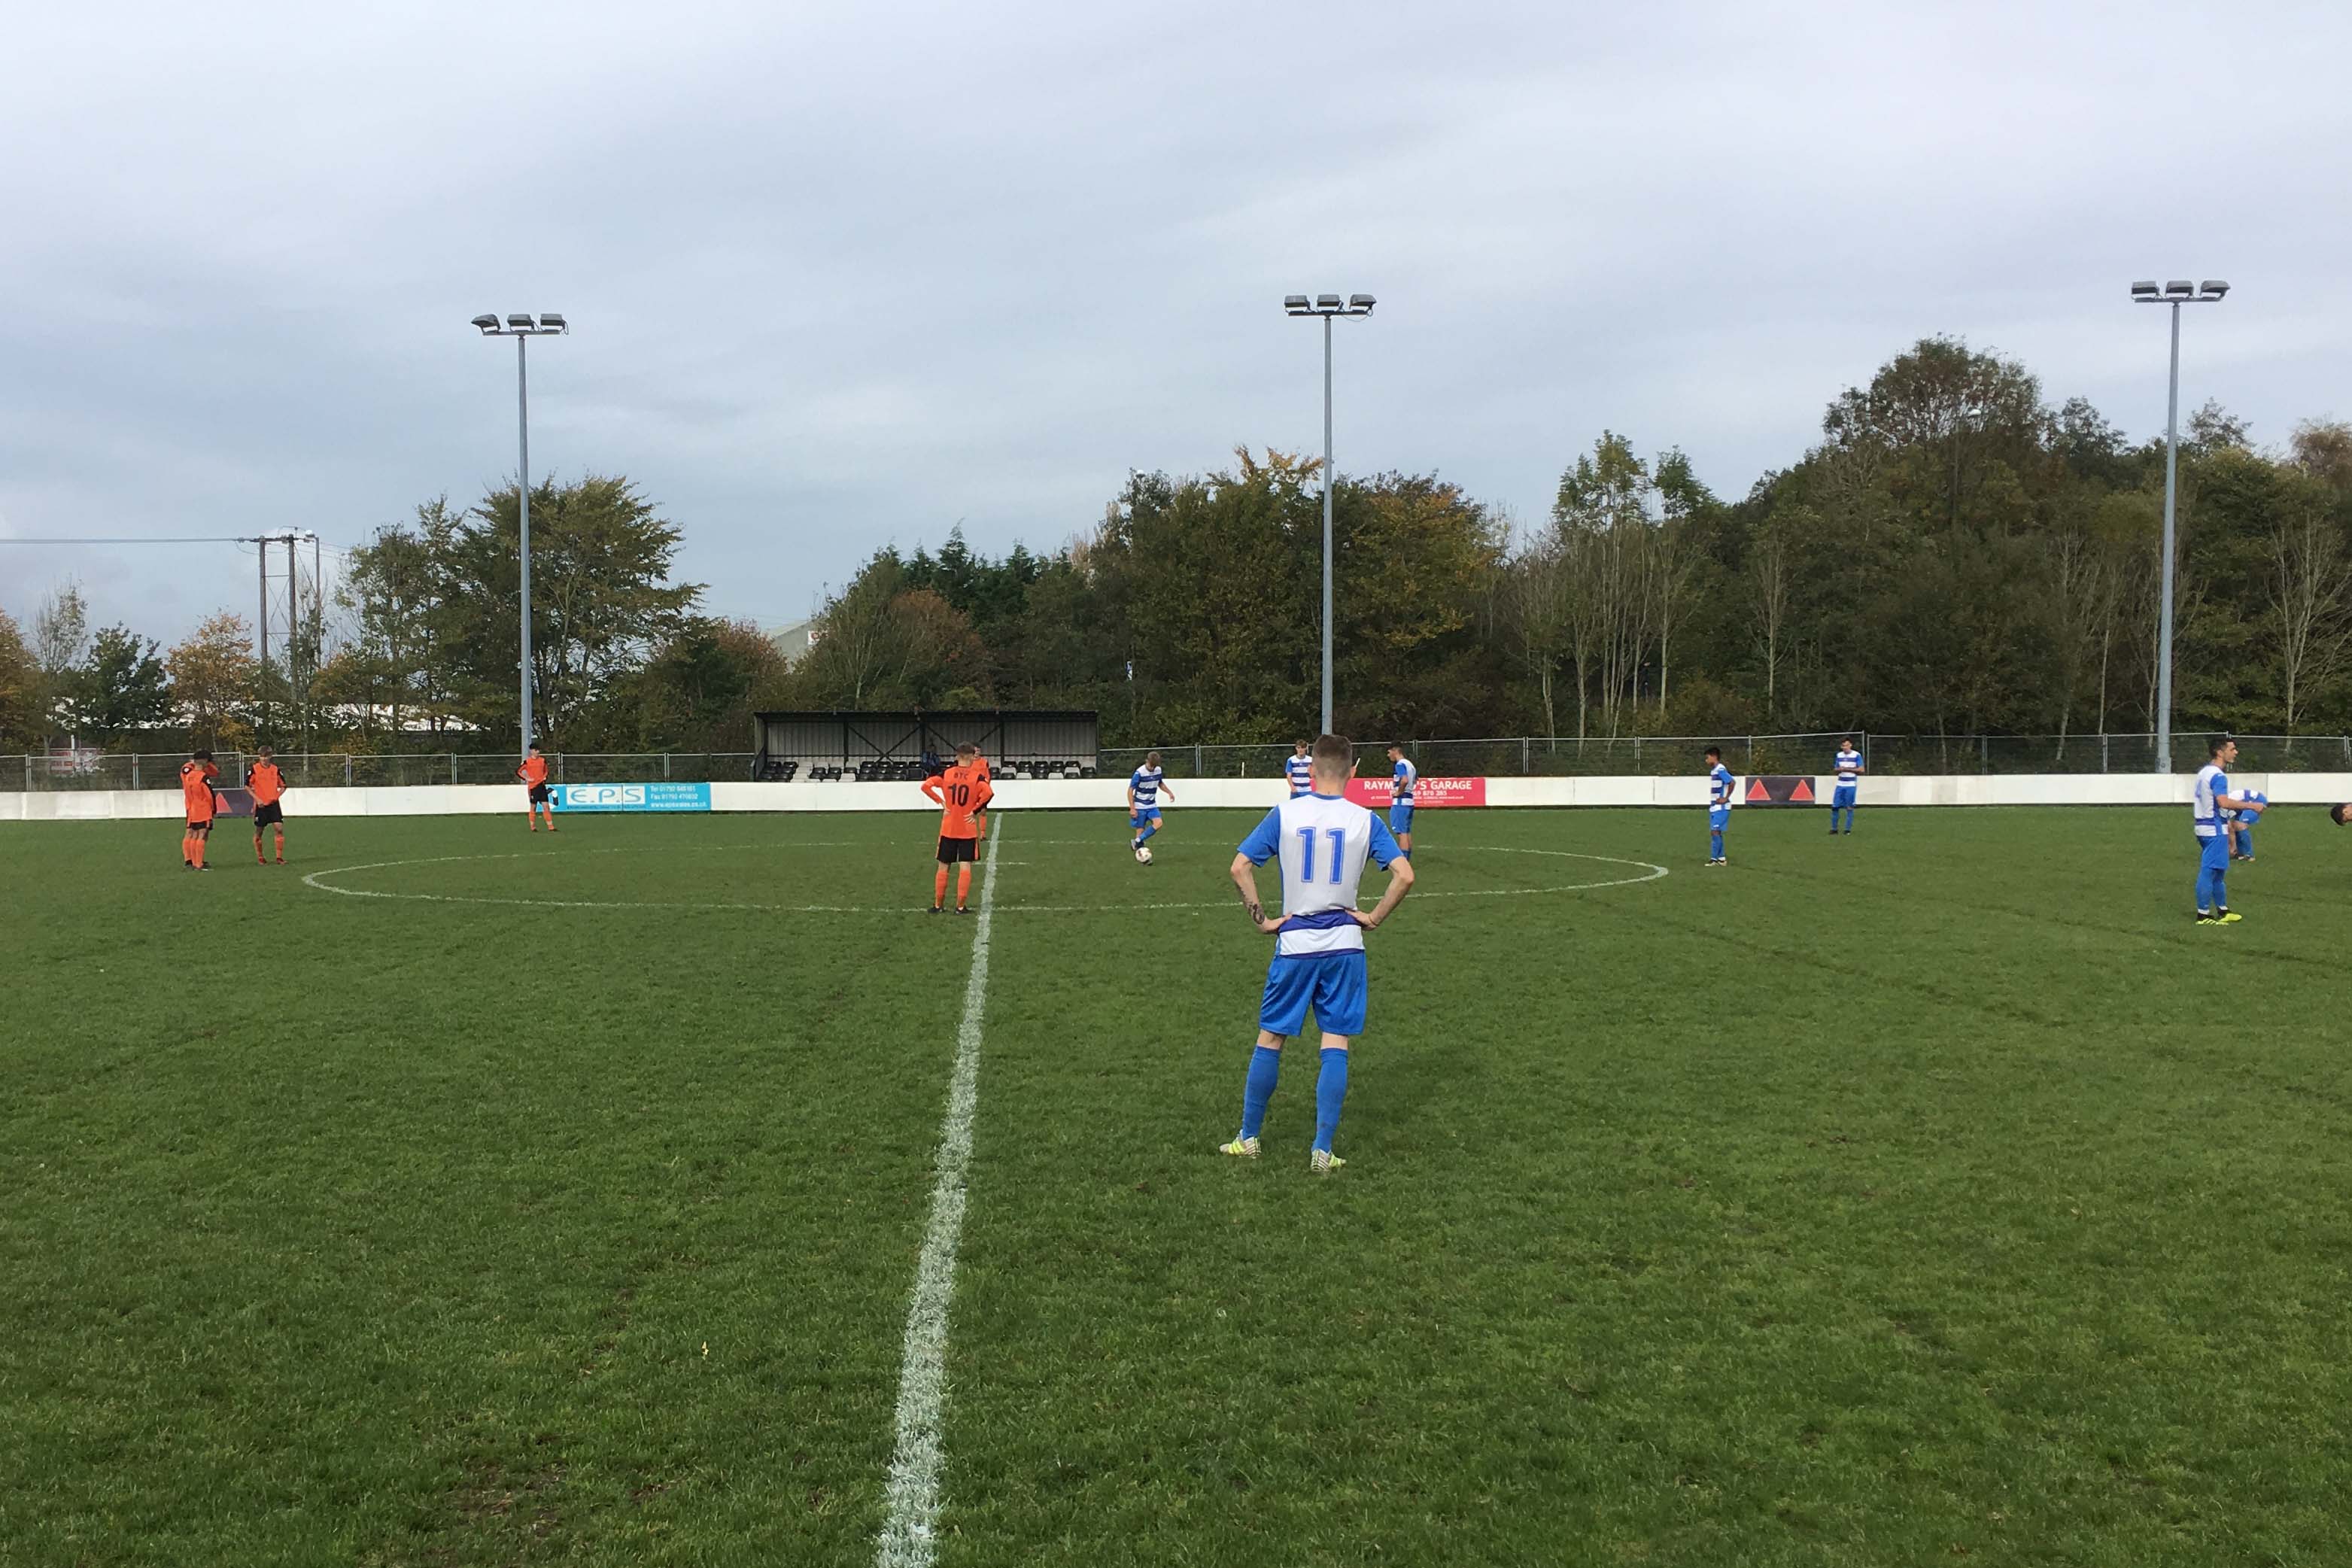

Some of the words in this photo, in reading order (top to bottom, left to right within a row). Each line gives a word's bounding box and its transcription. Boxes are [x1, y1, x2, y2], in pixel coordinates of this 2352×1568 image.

[948, 783, 969, 807] 10
[1364, 780, 1427, 790] RAYM'S
[1430, 780, 1472, 790] GARAGE
[1296, 826, 1345, 885] 11
